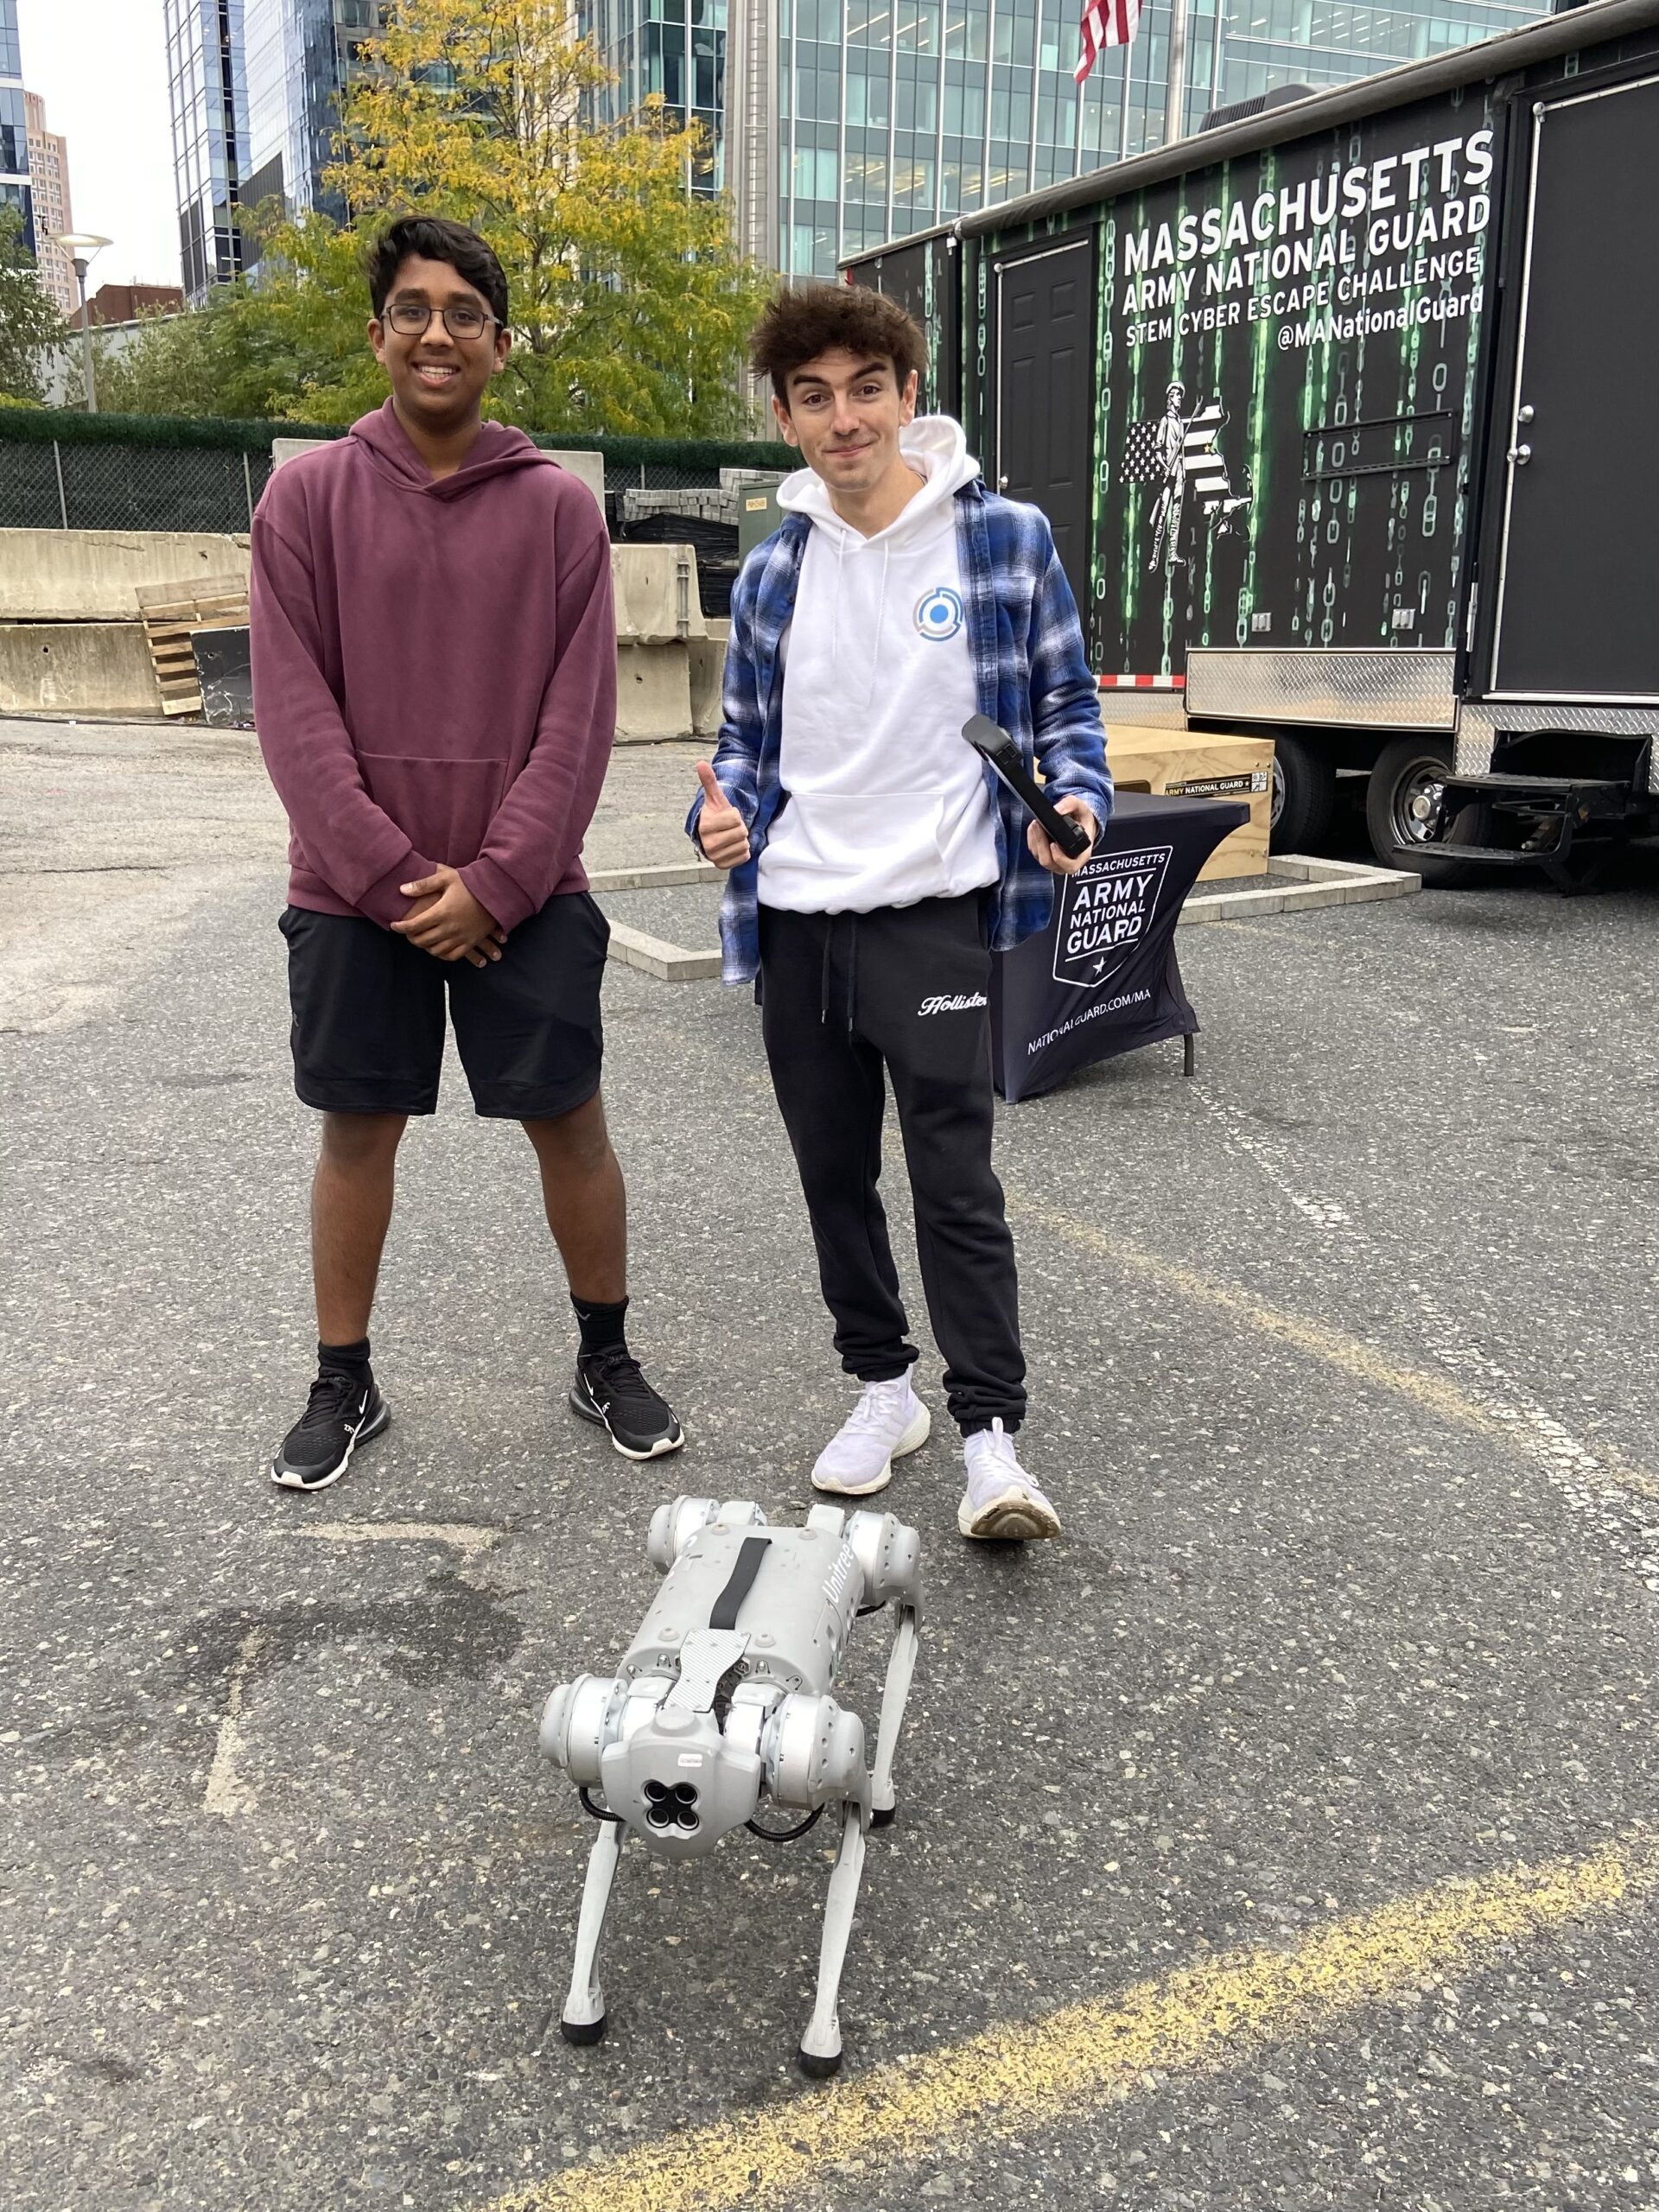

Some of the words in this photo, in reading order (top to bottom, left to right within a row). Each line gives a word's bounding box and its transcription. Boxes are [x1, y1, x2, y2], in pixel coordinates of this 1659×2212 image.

[1124, 130, 1494, 276] MASSACHUSETTS
[1122, 267, 1197, 316] ARMY
[1205, 228, 1357, 296] NATIONAL
[1368, 194, 1491, 257] GUARD
[1125, 316, 1173, 347] STEM
[1179, 302, 1241, 336] CYBER
[1247, 281, 1330, 321] ESCAPE
[1338, 246, 1481, 302] CHALLENGE
[1277, 284, 1484, 351] @MANationalGuard
[1164, 786, 1185, 797] ARMY
[1185, 783, 1219, 795] NATIONAL
[1219, 780, 1243, 791] GUARD
[1070, 899, 1146, 930] NATIONAL
[1072, 874, 1154, 912] ARMY
[1066, 915, 1142, 954] GUARD
[822, 1542, 854, 1604] Unitree
